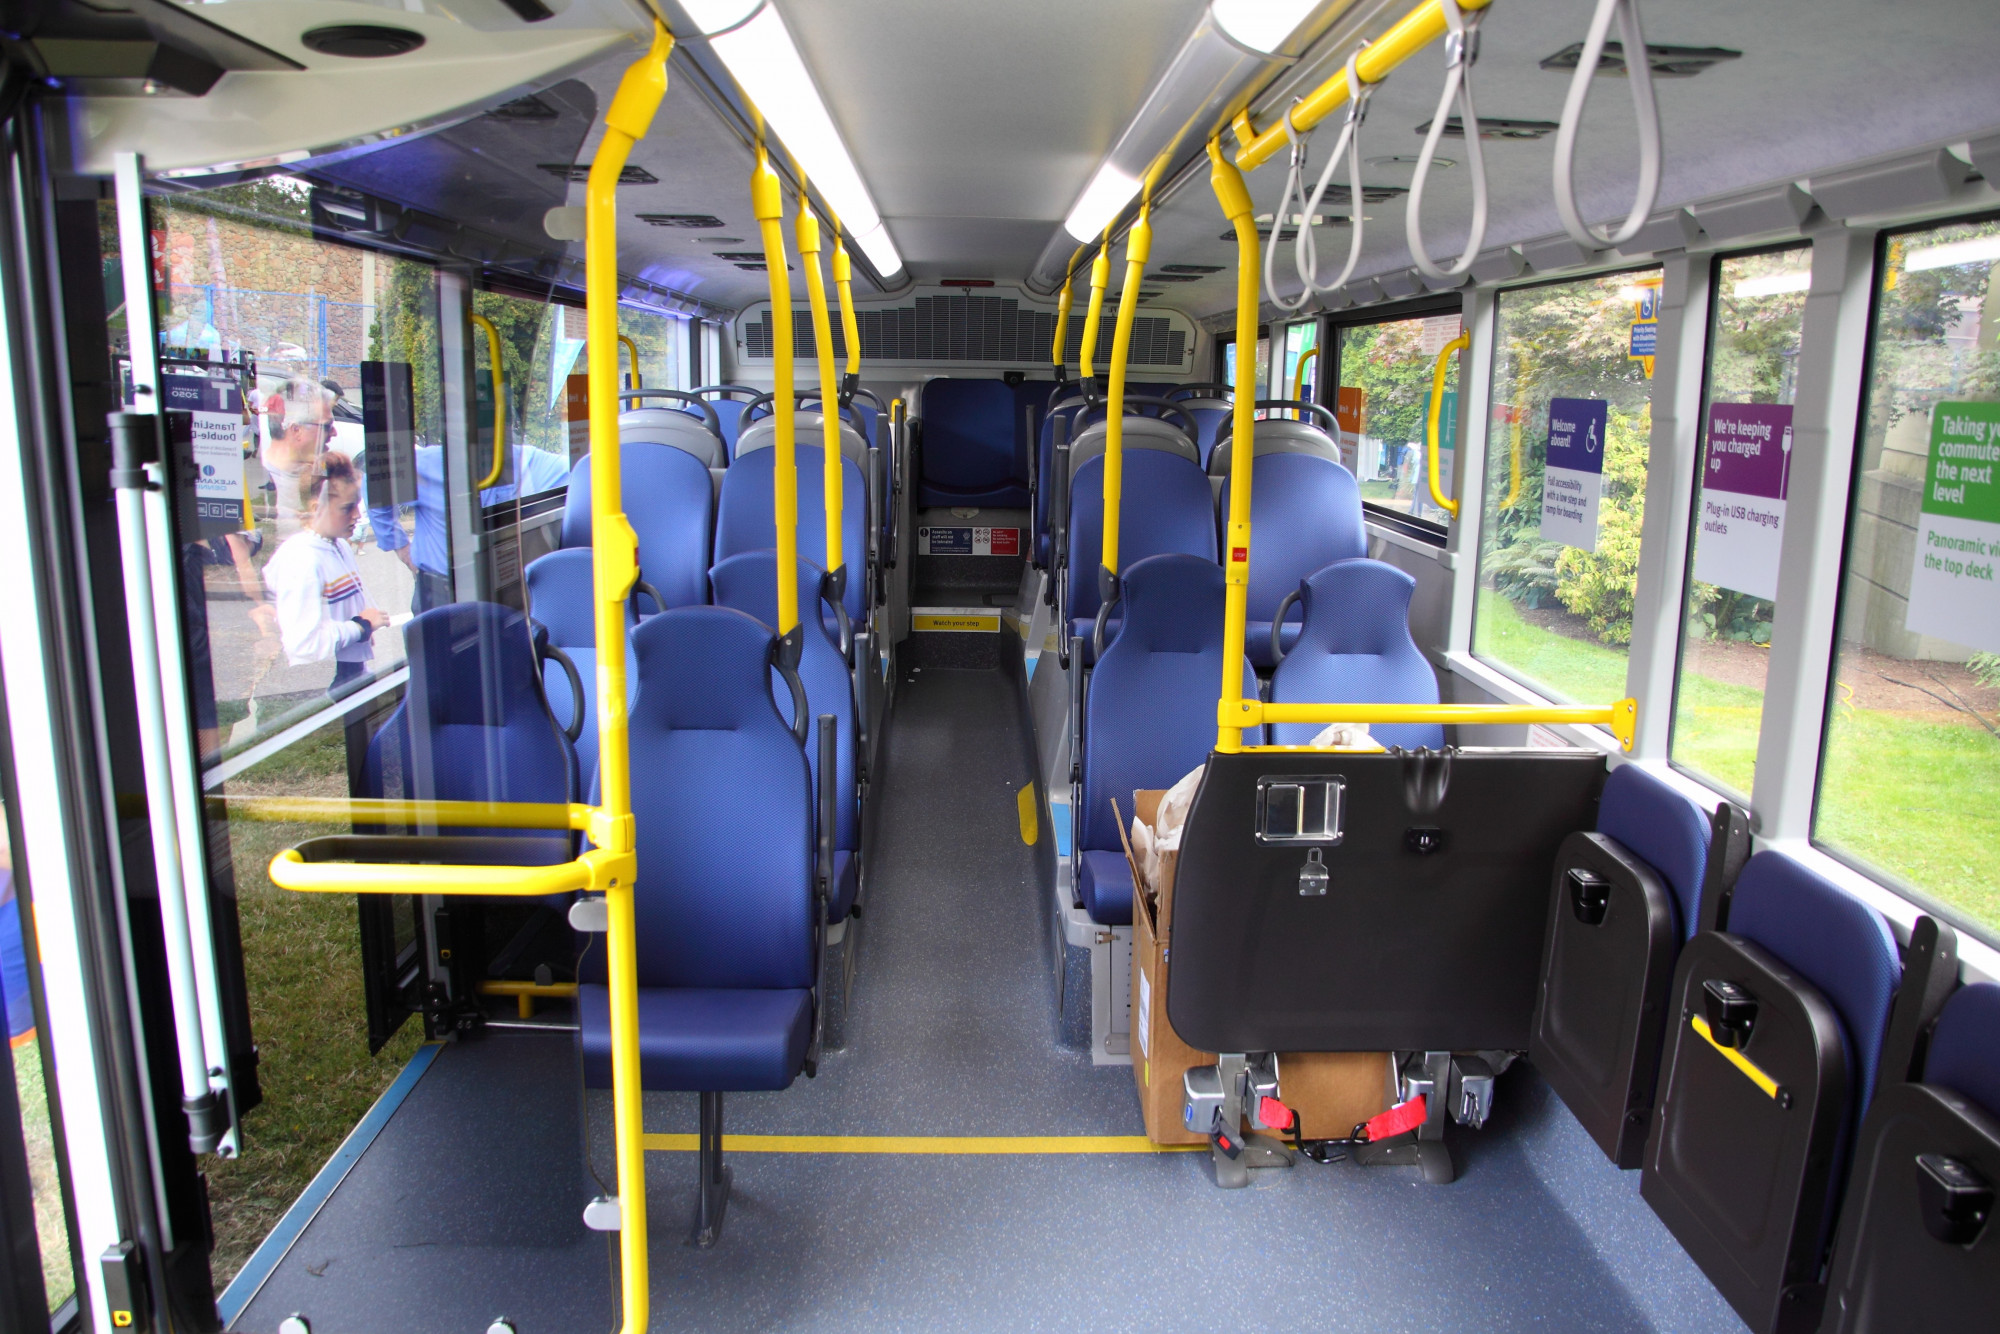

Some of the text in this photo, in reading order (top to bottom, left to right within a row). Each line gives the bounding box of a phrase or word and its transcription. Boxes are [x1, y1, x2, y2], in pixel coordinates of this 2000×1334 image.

[1552, 418, 1576, 433] Welcome
[1714, 418, 1772, 441] We're keeping
[1942, 415, 1986, 442] Taking
[1550, 435, 1571, 448] aboard!
[1712, 439, 1761, 458] you charged
[1938, 441, 2000, 462] commute
[1710, 457, 1721, 473] up
[1936, 460, 1992, 484] the next
[1547, 476, 1582, 494] Full accessibility
[1932, 481, 1965, 504] level
[1546, 492, 1556, 501] with
[1568, 495, 1577, 507] step
[1578, 496, 1587, 508] and
[1545, 505, 1556, 516] ramp
[1562, 506, 1583, 524] boarding
[1706, 501, 1779, 529] Plug-in USB charging
[1704, 519, 1728, 535] outlets
[1927, 530, 1986, 556] Panoramic
[1924, 552, 1994, 582] the top deck
